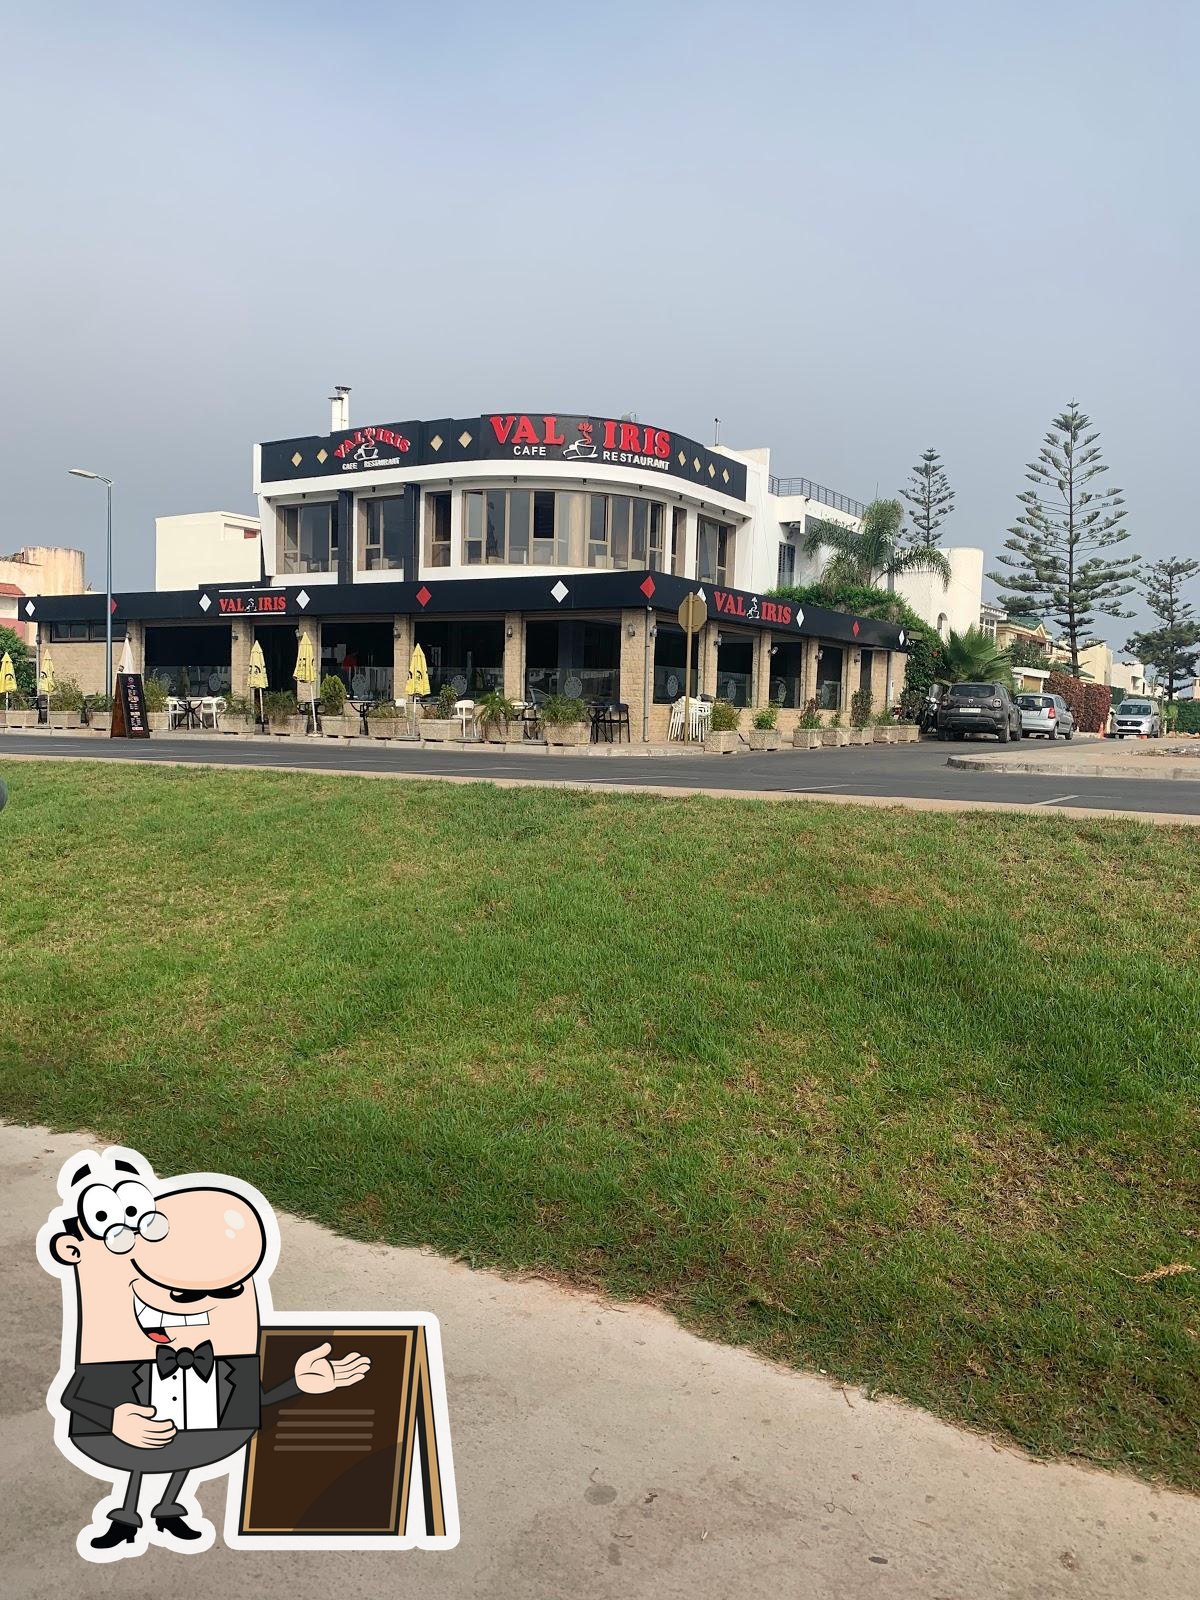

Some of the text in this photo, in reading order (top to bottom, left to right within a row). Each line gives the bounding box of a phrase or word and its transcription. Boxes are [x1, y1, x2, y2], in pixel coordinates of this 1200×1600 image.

[334, 427, 411, 458] VAL IRIS
[489, 415, 671, 459] VAL IRIS
[342, 462, 358, 471] CAFE
[513, 446, 670, 471] CAFE RESTAURANT
[219, 596, 286, 612] VAL IRIS
[714, 591, 792, 625] VAL IRIS
